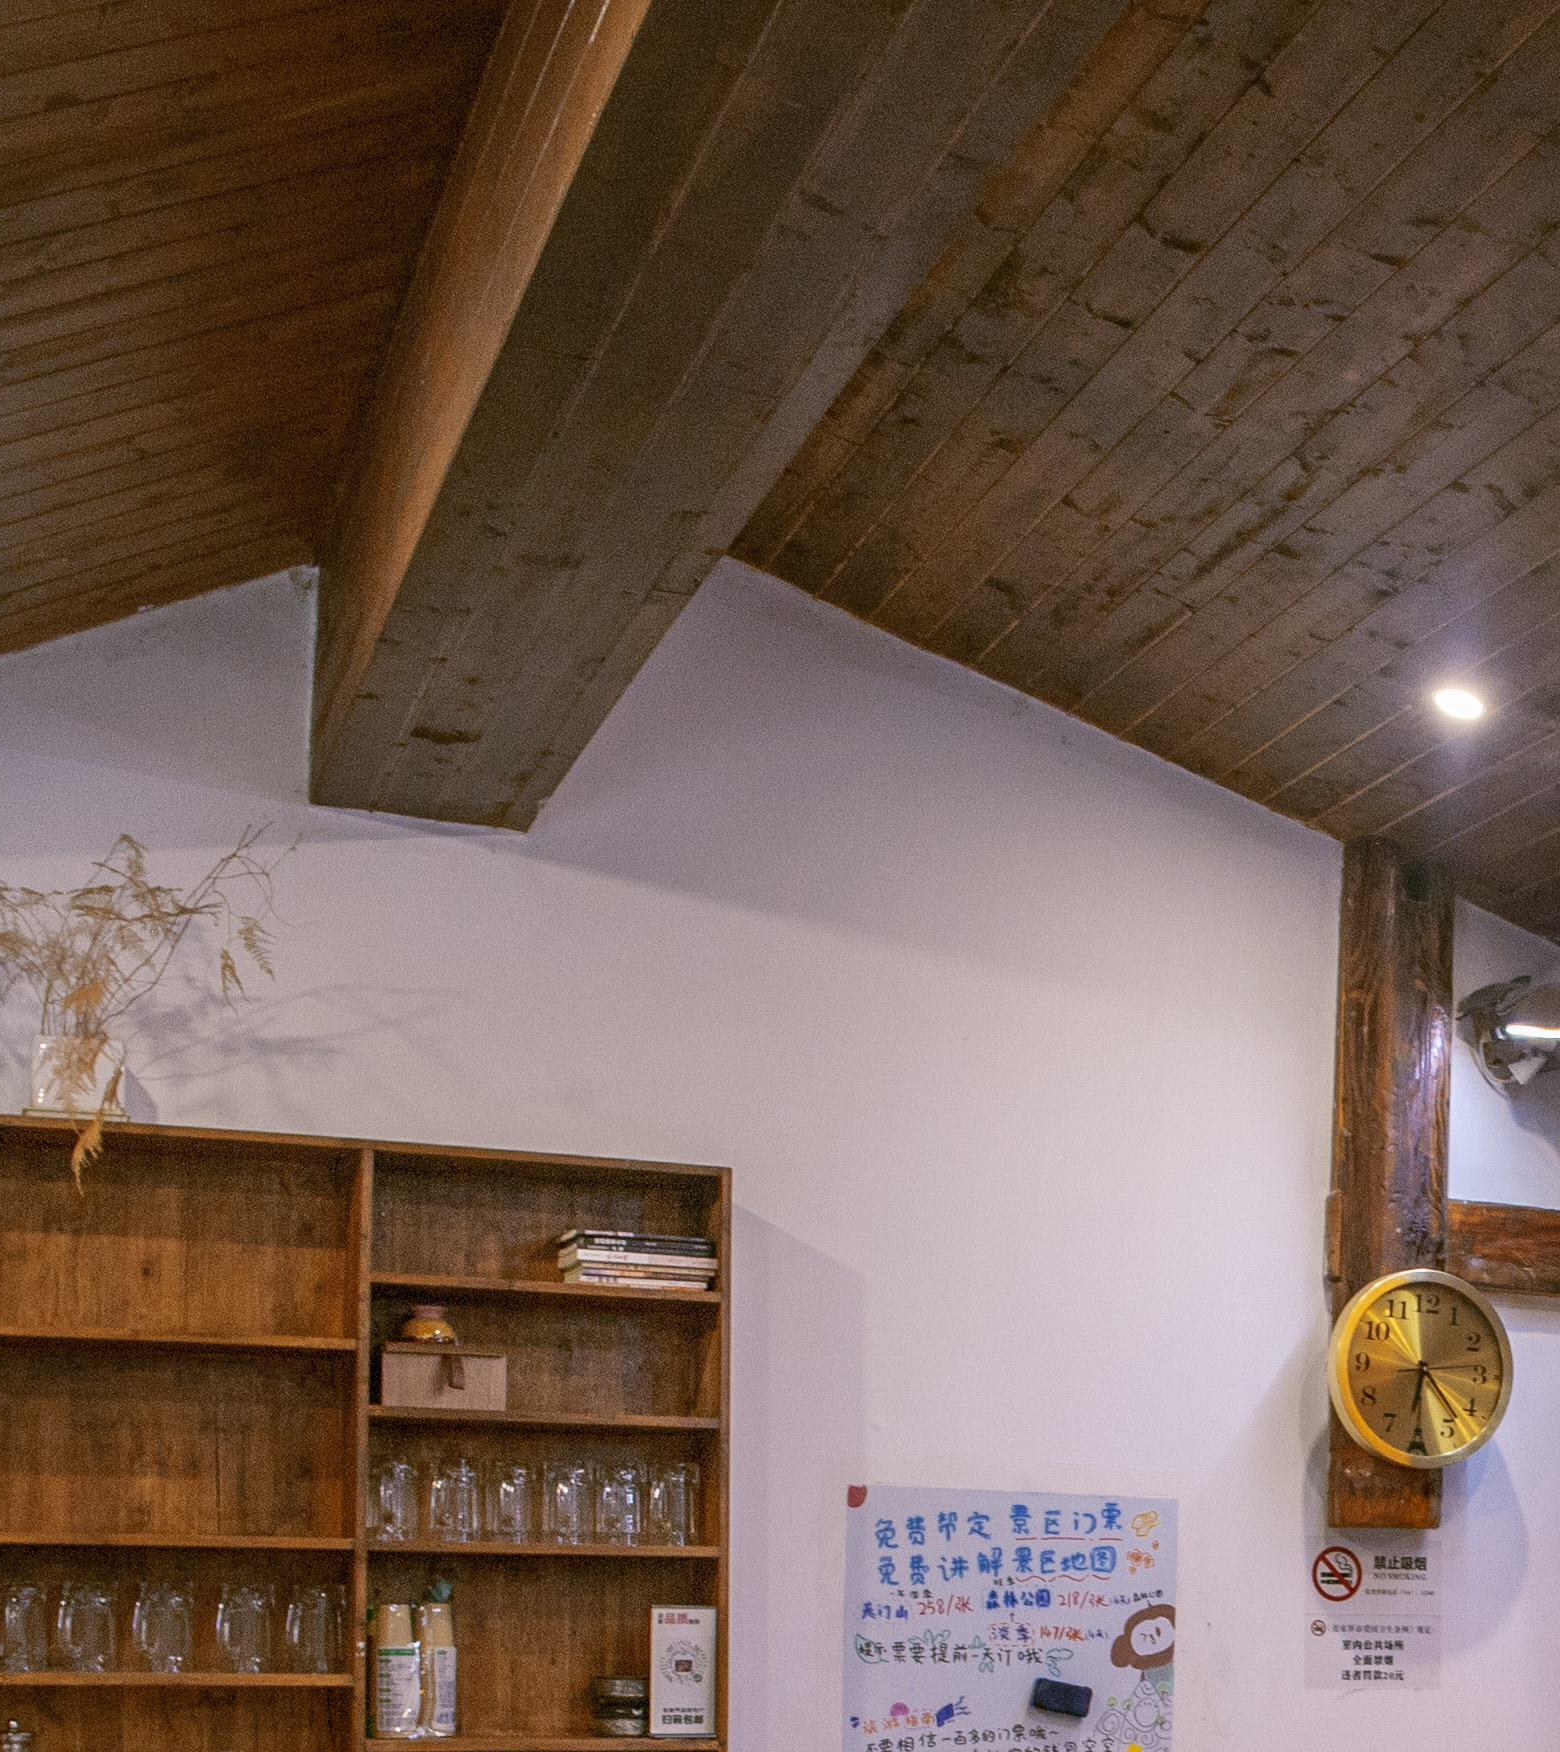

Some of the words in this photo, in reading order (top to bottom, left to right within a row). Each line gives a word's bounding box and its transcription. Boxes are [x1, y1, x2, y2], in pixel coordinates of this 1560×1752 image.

[1386, 1299, 1409, 1320] 11
[1415, 1294, 1439, 1314] 12
[1450, 1306, 1458, 1326] 1
[1364, 1320, 1389, 1341] 10
[1465, 1332, 1481, 1352] 2
[1354, 1352, 1370, 1372] 9
[1472, 1365, 1487, 1385] 3
[1361, 1386, 1377, 1406] 8
[1463, 1398, 1477, 1417] 4
[1384, 1412, 1397, 1433] 7
[1440, 1418, 1454, 1439] 5
[1374, 1555, 1427, 1571] 禁止吸烟
[991, 1624, 1030, 1643] 淡季
